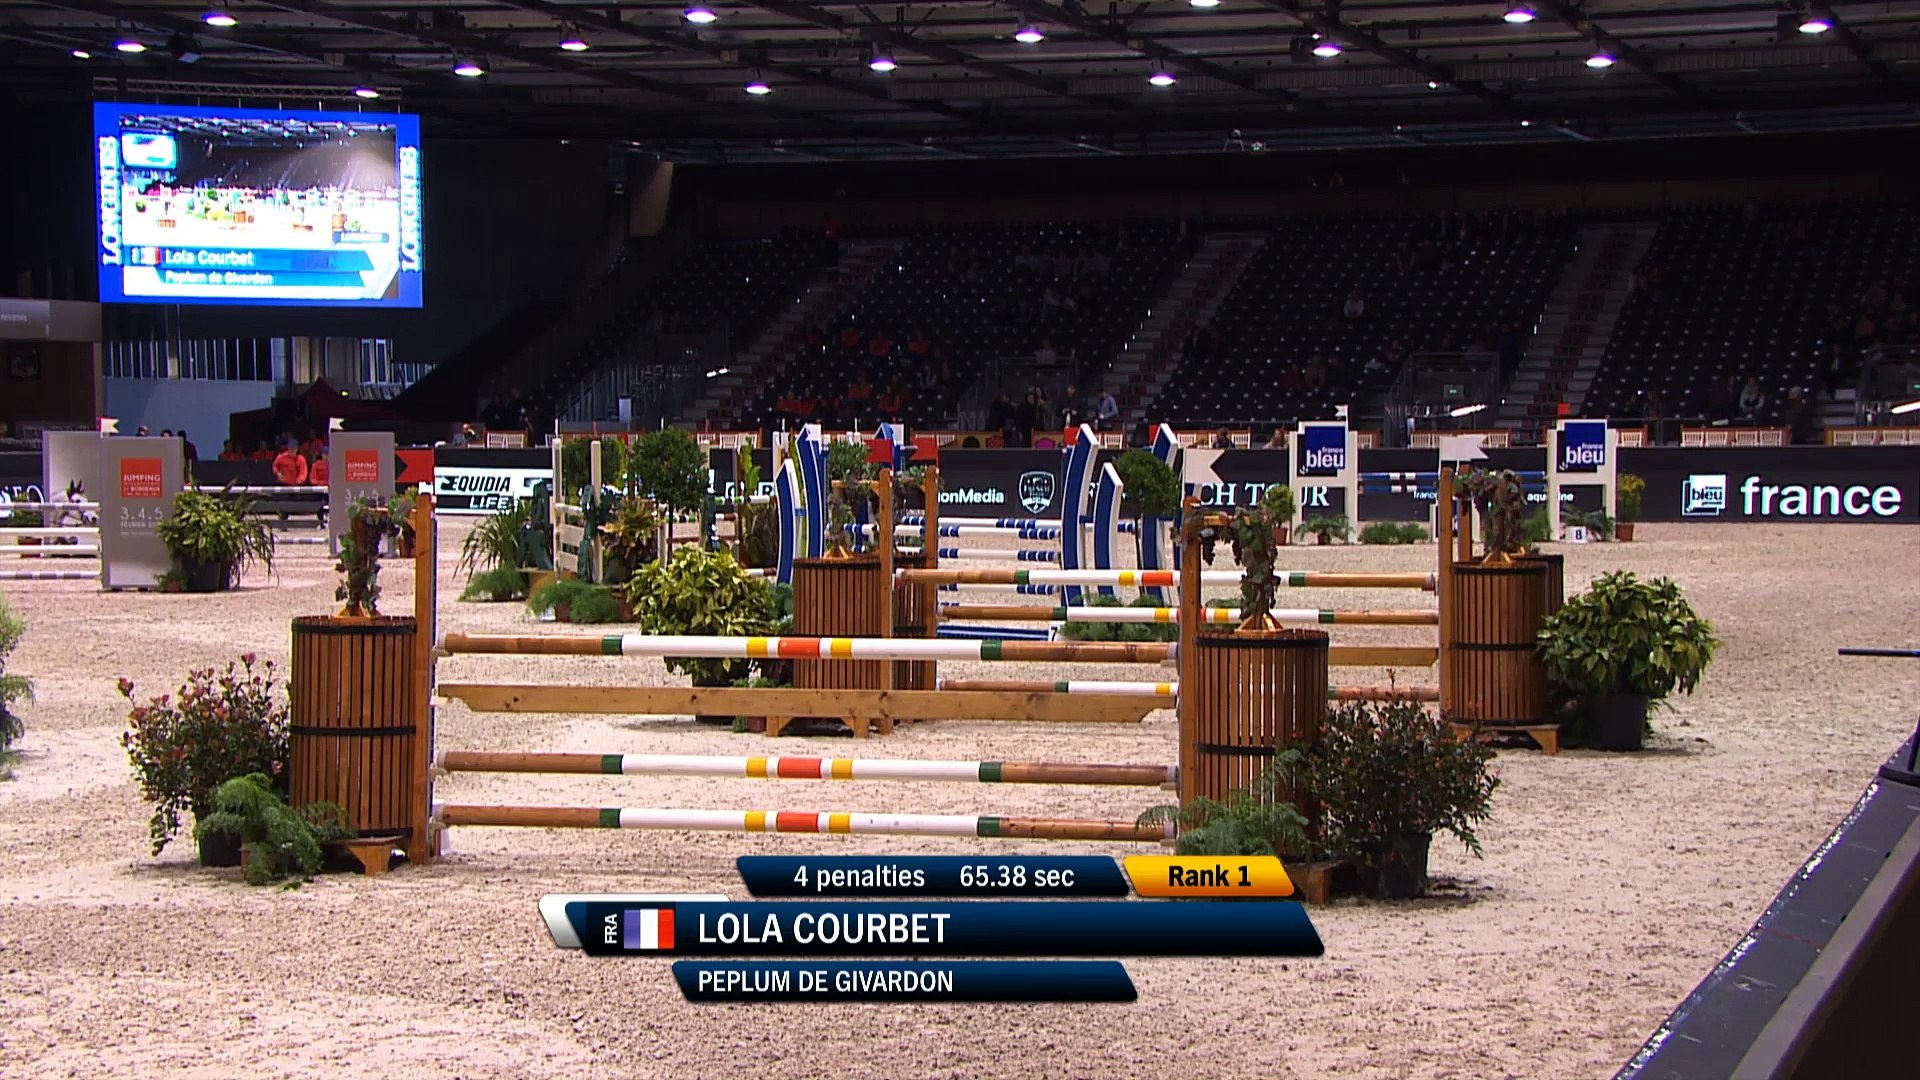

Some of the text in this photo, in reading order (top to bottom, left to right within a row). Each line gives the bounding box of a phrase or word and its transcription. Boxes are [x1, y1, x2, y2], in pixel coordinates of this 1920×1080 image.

[165, 249, 255, 266] Lola Courbet
[1306, 449, 1344, 468] bleu
[1566, 446, 1604, 465] bleu
[441, 475, 511, 492] EQUIDIA
[470, 495, 510, 510] LIFE
[1692, 488, 1722, 501] bleu
[1740, 476, 1902, 516] france
[1575, 529, 1583, 541] 8
